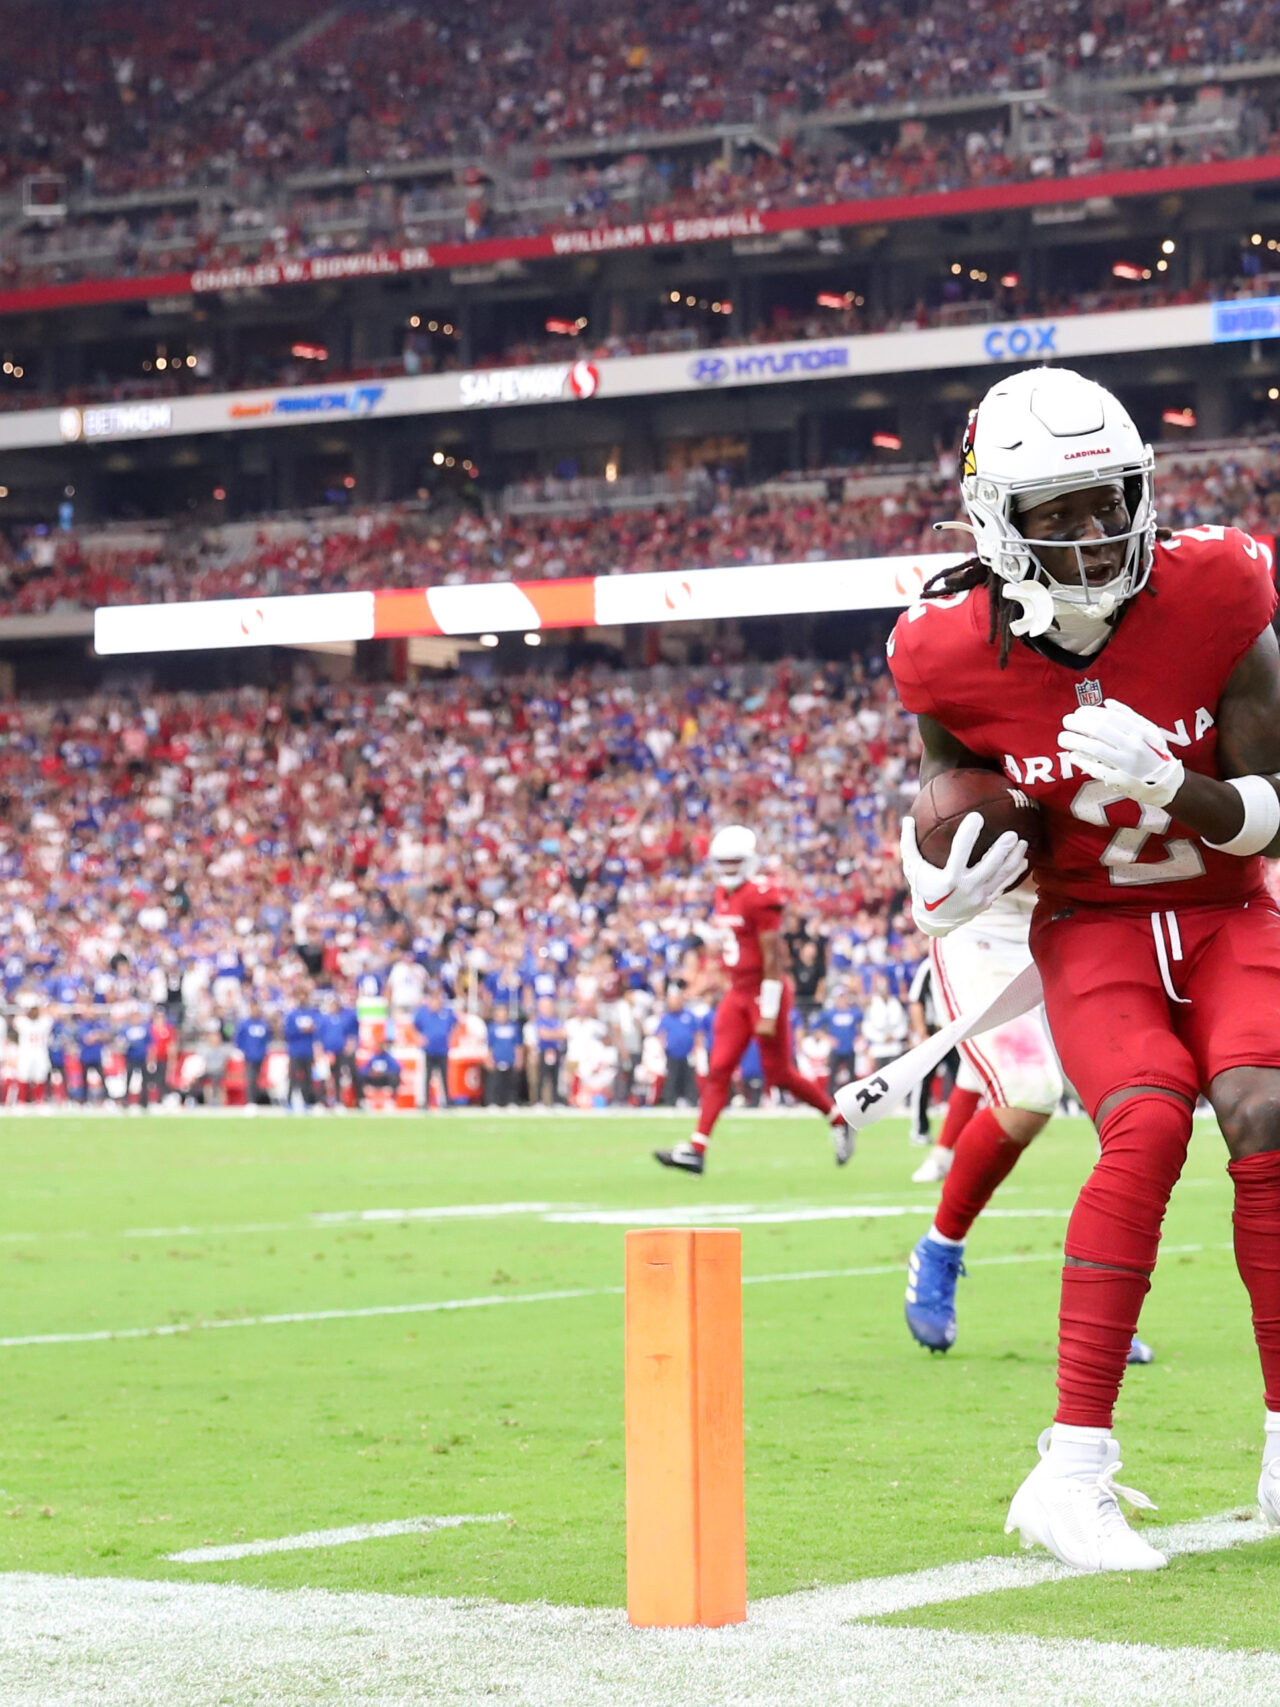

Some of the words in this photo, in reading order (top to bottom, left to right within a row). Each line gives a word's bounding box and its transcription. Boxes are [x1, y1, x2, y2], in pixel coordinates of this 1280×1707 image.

[552, 224, 645, 254] WILLIAM
[984, 325, 1057, 359] COX
[735, 348, 849, 375] HYUNDAI
[459, 369, 570, 405] SAFEWAY
[1063, 447, 1111, 460] CARDINALS
[1070, 778, 1207, 886] 2
